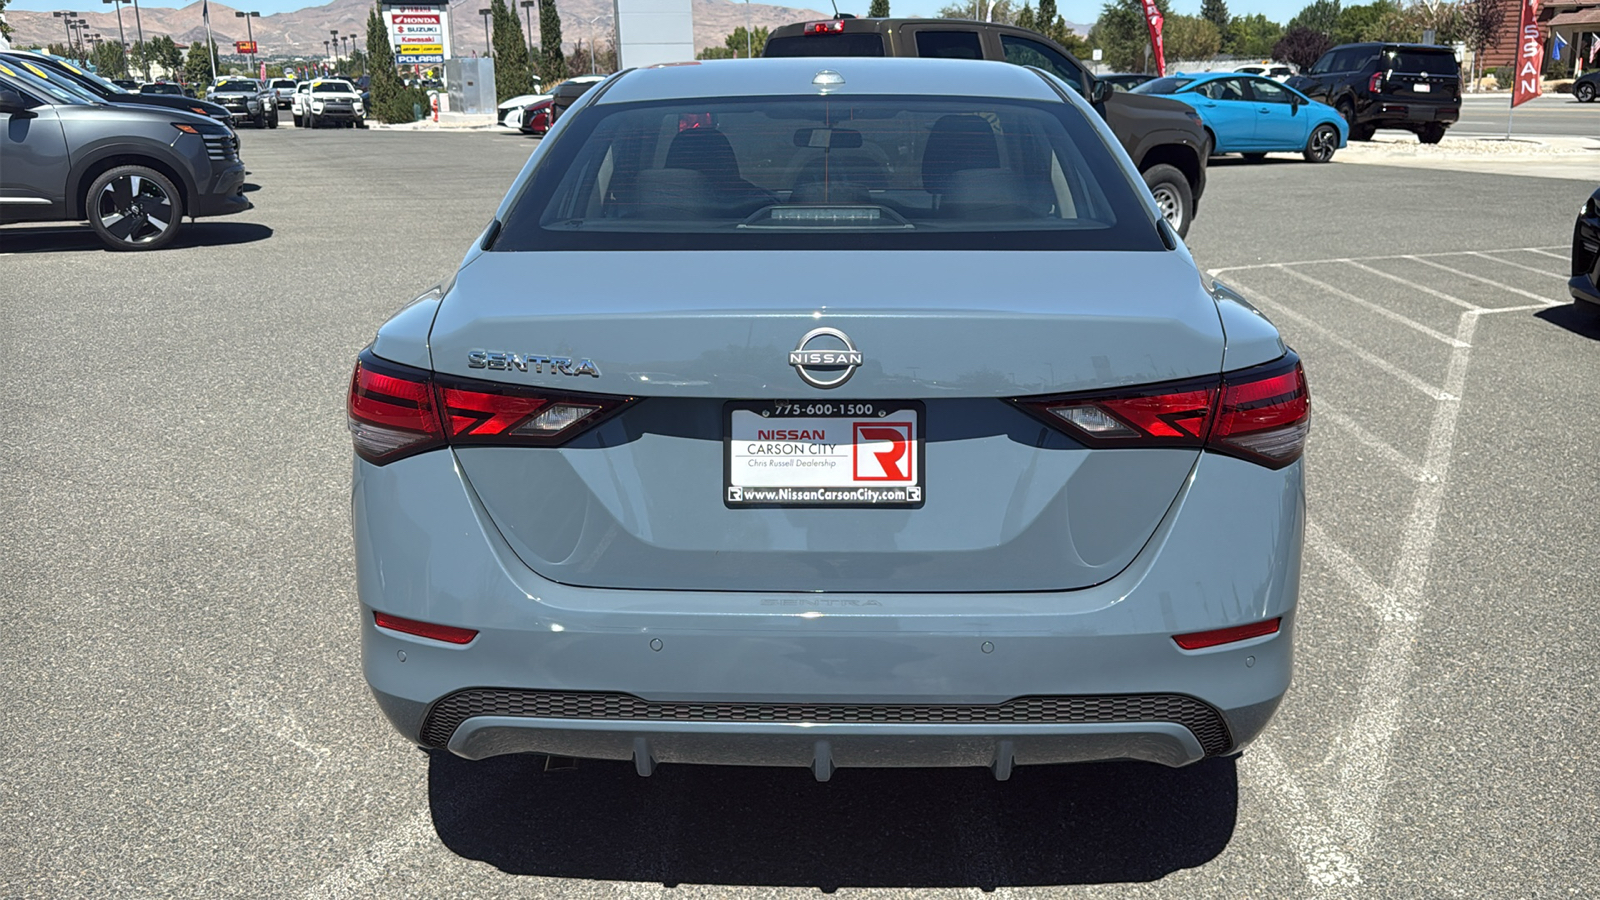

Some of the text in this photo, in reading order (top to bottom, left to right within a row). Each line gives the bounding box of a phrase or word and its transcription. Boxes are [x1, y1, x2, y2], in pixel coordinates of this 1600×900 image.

[1520, 0, 1539, 94] SSAN
[467, 347, 601, 378] SENTRA
[790, 353, 862, 363] NISSAN
[775, 404, 873, 415] 775-600-1500
[758, 430, 825, 440] NISSAN
[747, 443, 837, 455] CARSON CITY
[747, 458, 837, 469] Chris Russell Dealership
[744, 488, 905, 503] www.NissanCarsonCity.com
[760, 599, 883, 607] SENTRA
